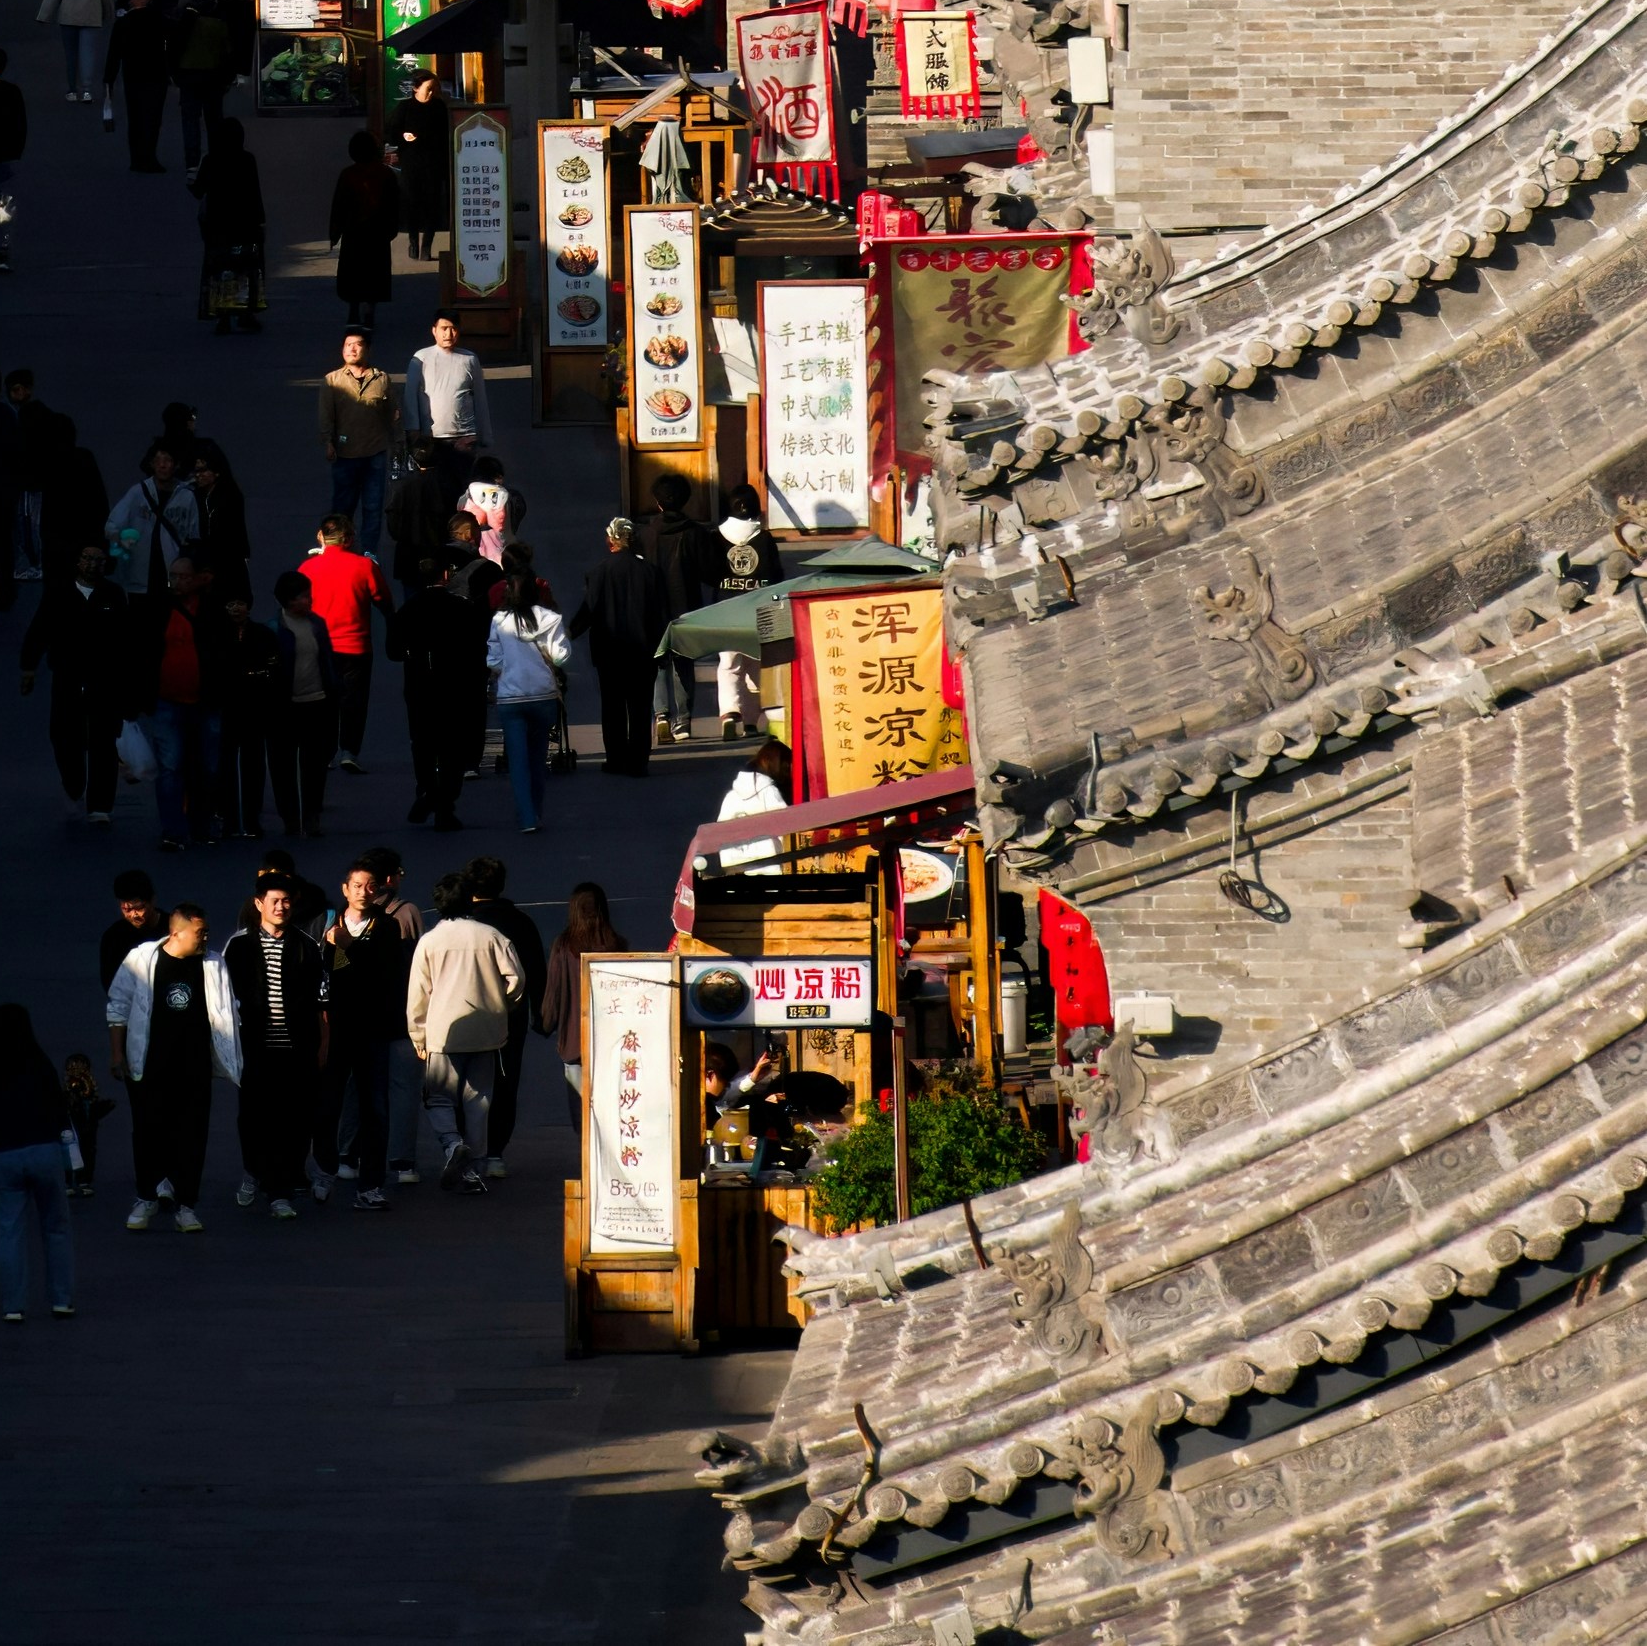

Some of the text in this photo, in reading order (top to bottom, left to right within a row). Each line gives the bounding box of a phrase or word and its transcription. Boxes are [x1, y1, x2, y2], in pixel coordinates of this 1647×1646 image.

[925, 20, 951, 94] 式服饰
[779, 320, 854, 348] 手工布鞋
[779, 358, 854, 382] 工艺布鞋
[781, 394, 854, 421] 中式服饰
[780, 433, 855, 456] 传统文化
[781, 468, 855, 495] 私人订制
[852, 602, 930, 787] 浑源凉粉
[754, 967, 861, 1001] 炒凉粉
[607, 994, 653, 1015] 正宗
